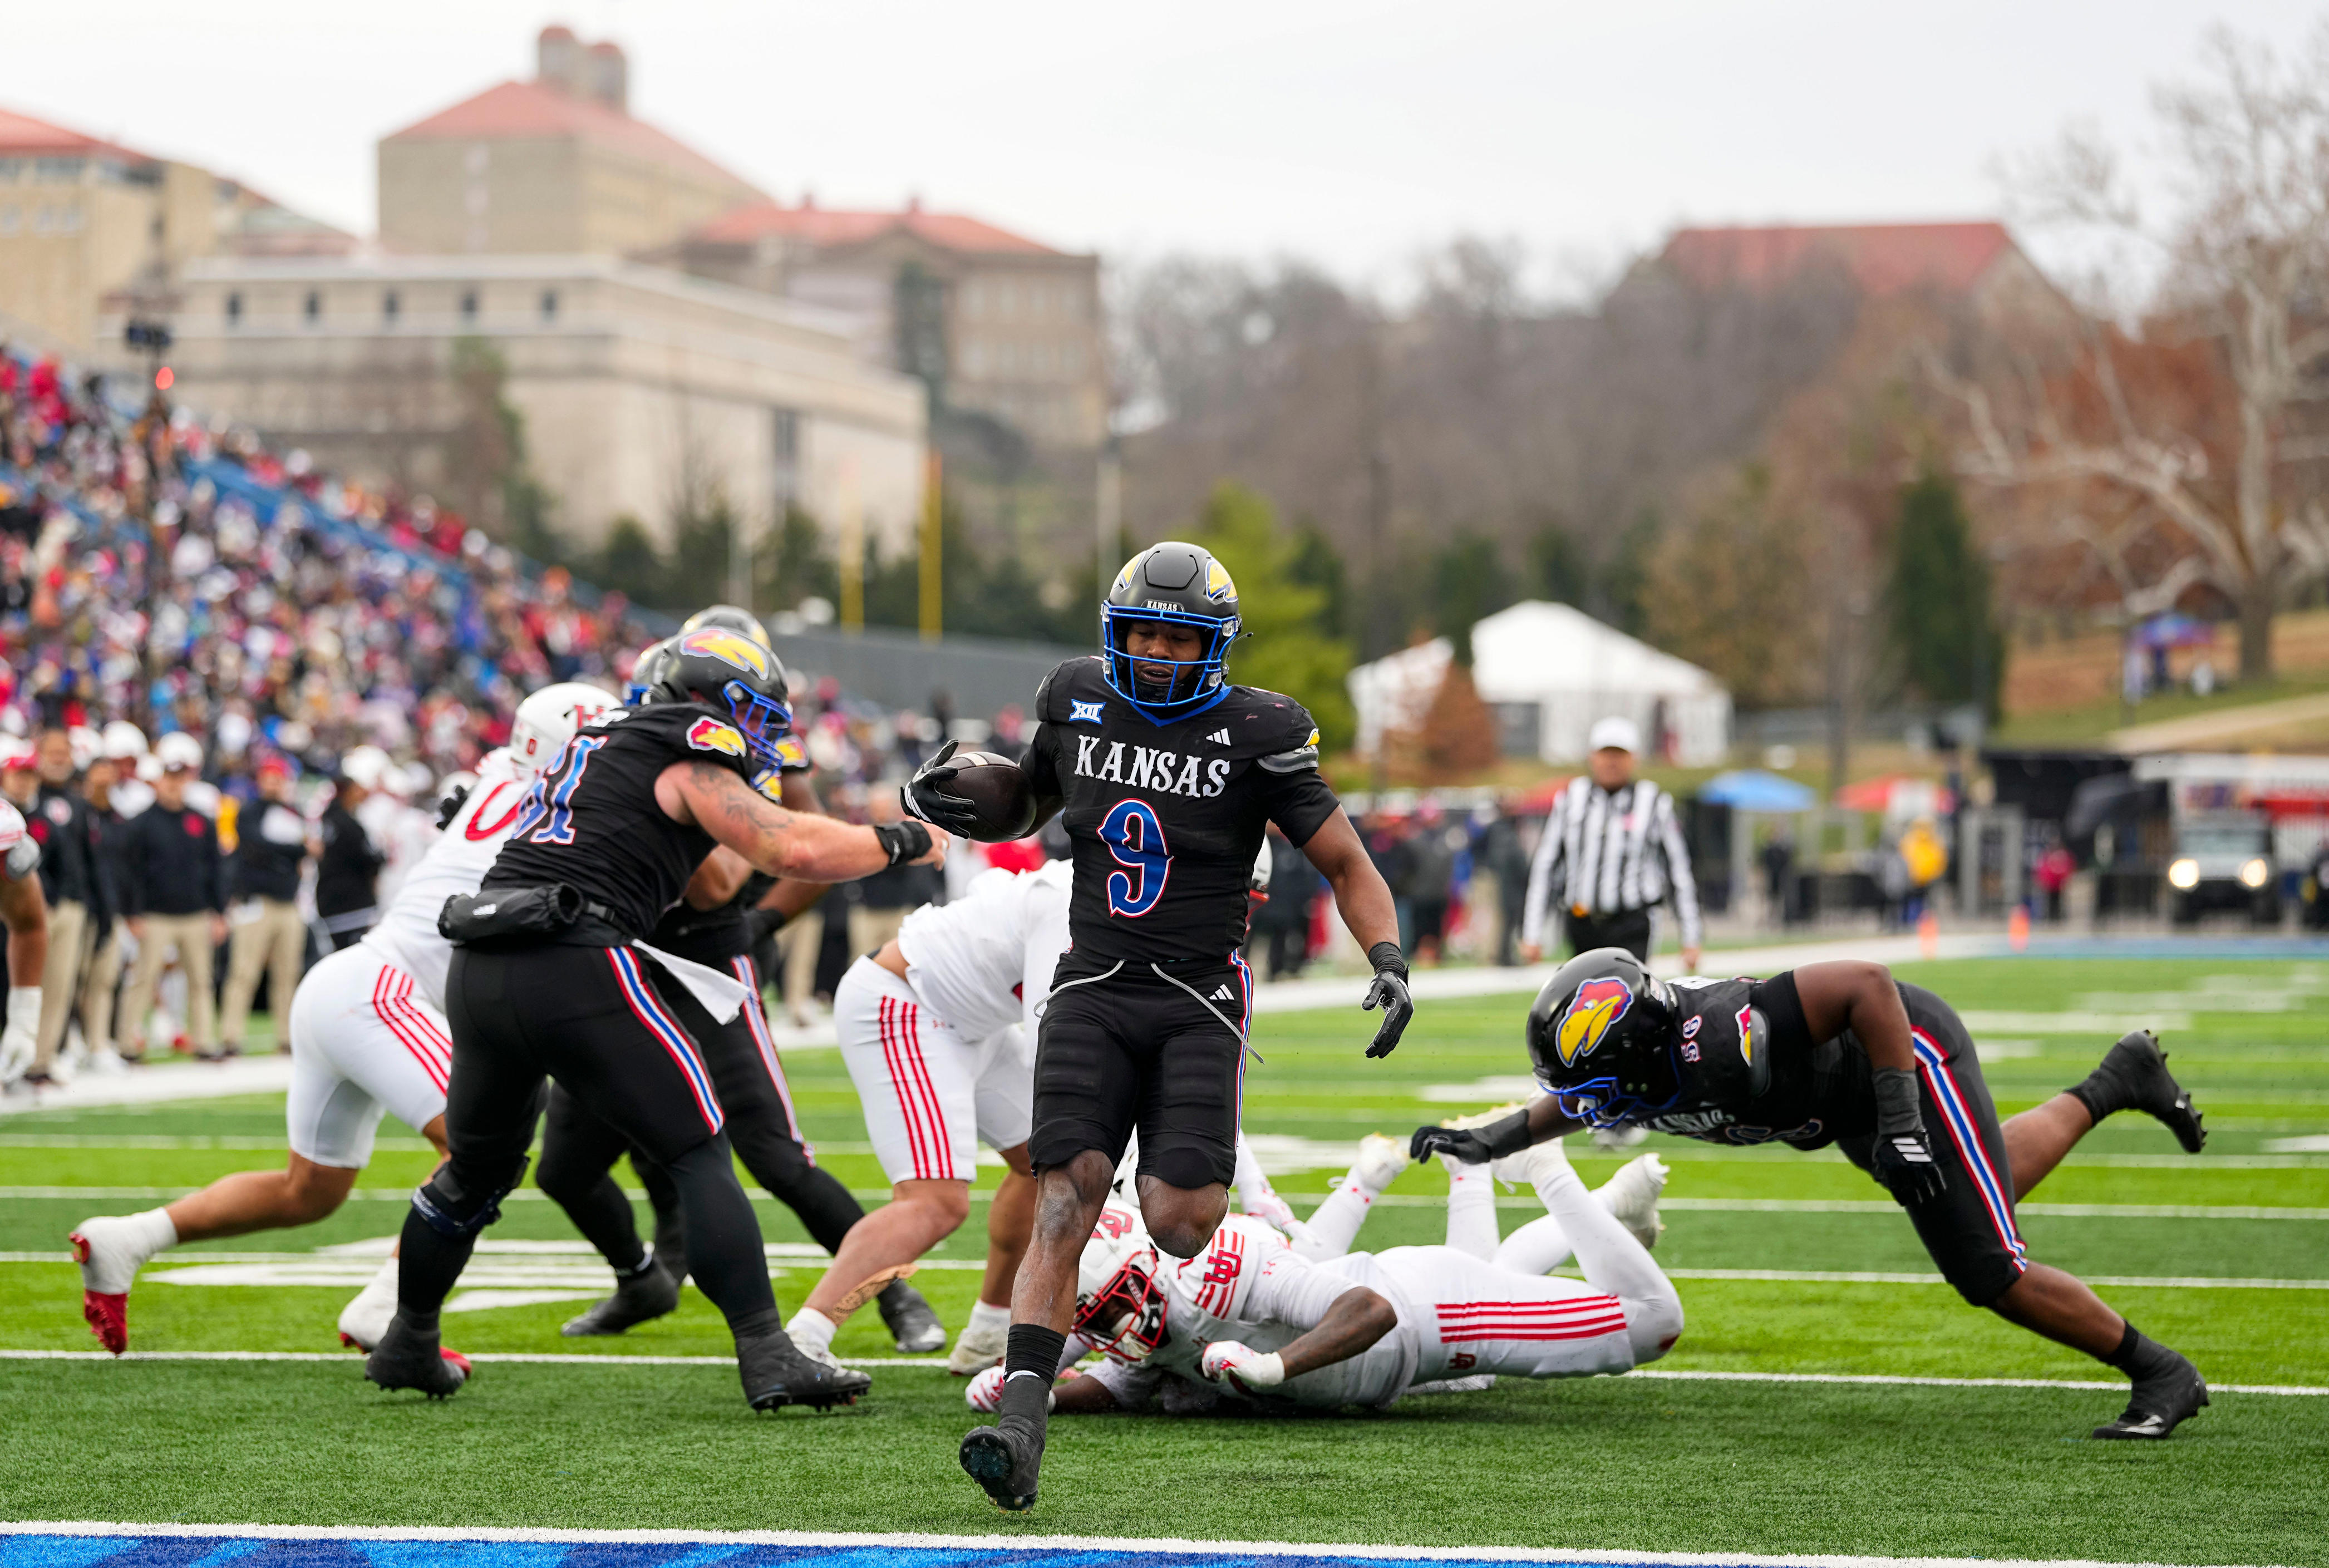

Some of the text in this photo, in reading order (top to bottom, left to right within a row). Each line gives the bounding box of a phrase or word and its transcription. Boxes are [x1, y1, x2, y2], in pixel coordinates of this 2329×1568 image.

[1146, 600, 1178, 612] KANSAS
[1071, 701, 1104, 723] XII
[1074, 734, 1230, 798] KANSAS
[1096, 797, 1175, 918] 9
[1681, 1014, 1703, 1063] 56
